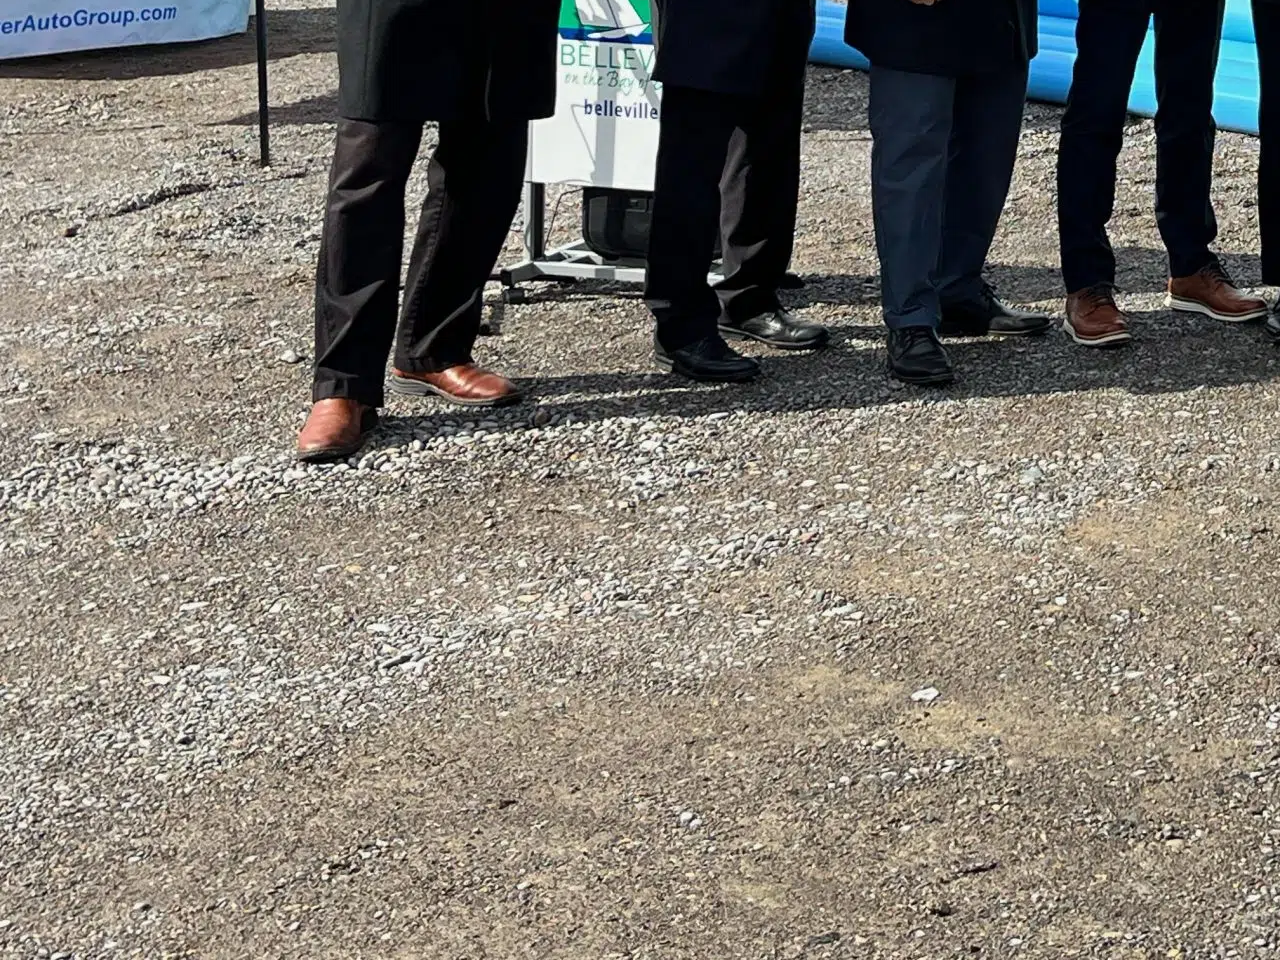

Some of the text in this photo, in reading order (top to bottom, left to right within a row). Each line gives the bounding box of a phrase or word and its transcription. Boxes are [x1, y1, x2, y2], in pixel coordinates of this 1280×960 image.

[0, 7, 177, 35] erAutoGroup.com
[561, 43, 656, 70] BELLEV
[584, 98, 659, 120] belleville
